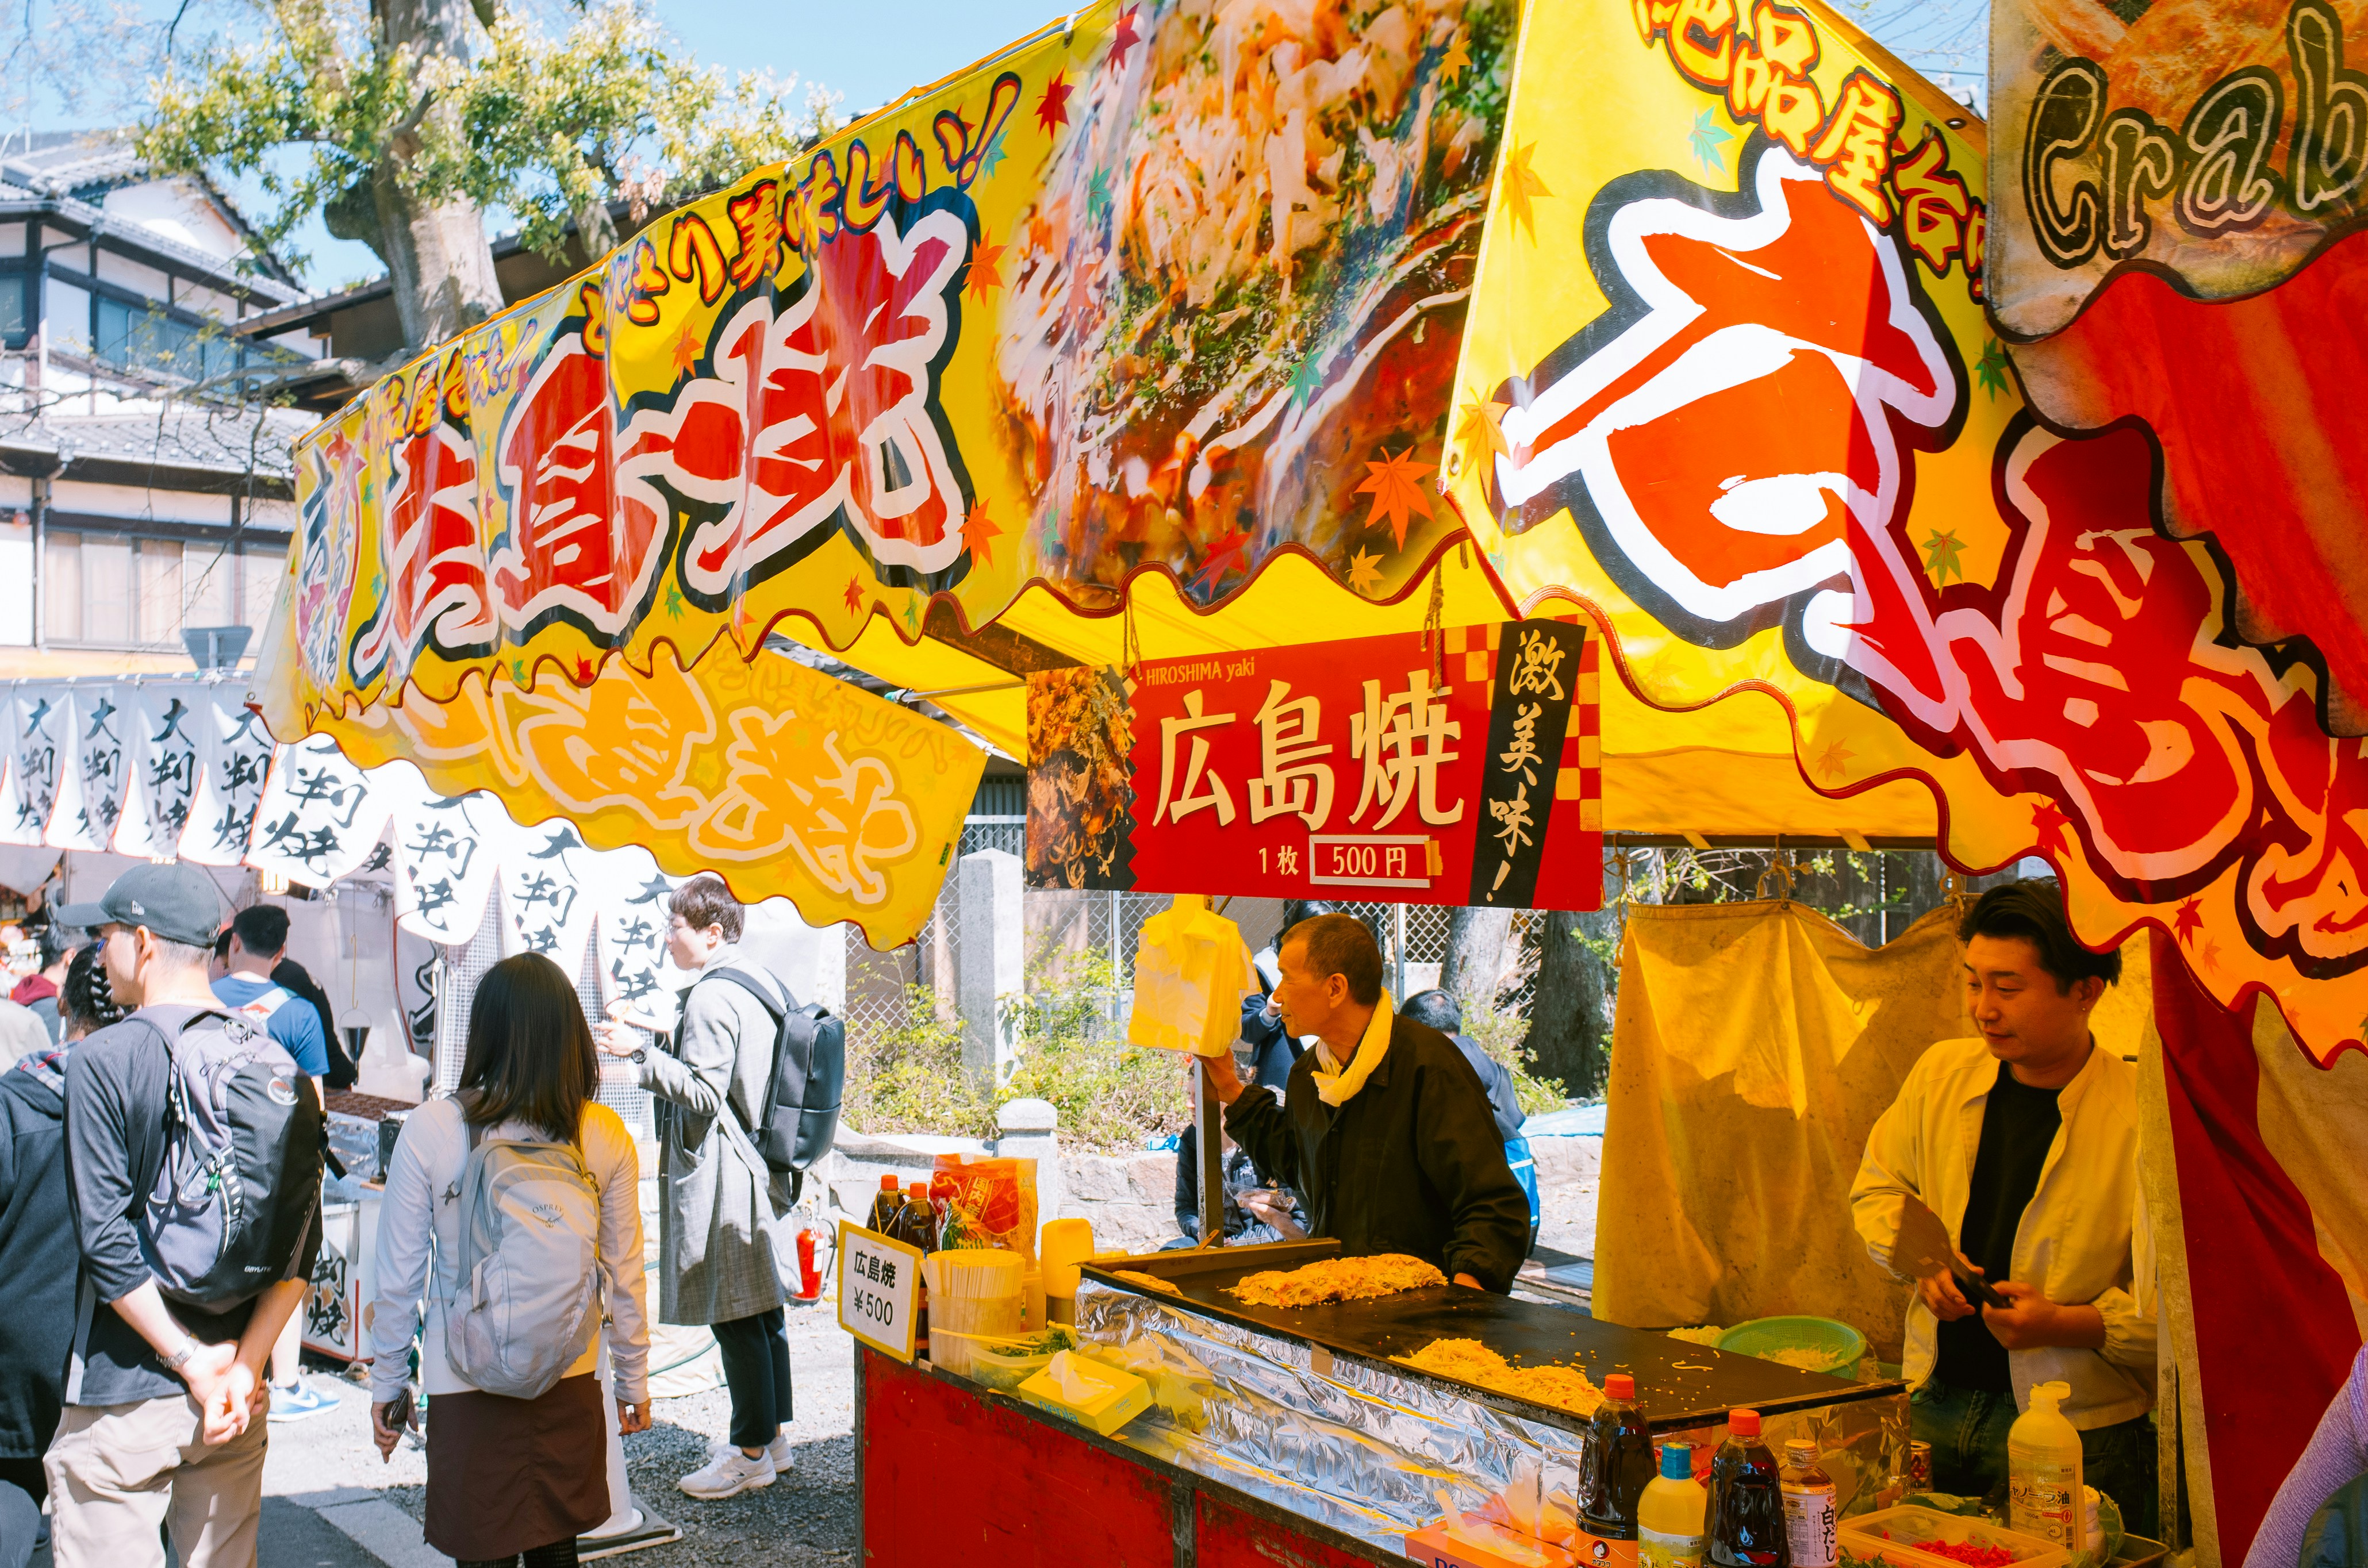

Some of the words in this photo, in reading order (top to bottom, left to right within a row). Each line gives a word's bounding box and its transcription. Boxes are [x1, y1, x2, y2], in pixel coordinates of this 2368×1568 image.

[2025, 5, 2368, 267] Crab
[1146, 661, 1222, 687] HIROSHIMA
[1225, 656, 1256, 683] yaki
[15, 698, 55, 831] 大判焼
[76, 697, 122, 836] 大判焼
[144, 698, 196, 843] 大判焼
[1152, 671, 1464, 832] 広島焼
[1485, 629, 1565, 904] 激美味!
[532, 1203, 563, 1214] OSPREY
[854, 1250, 896, 1289] 広島焼
[853, 1285, 894, 1327] ¥500
[1821, 1504, 1836, 1562] 白だし
